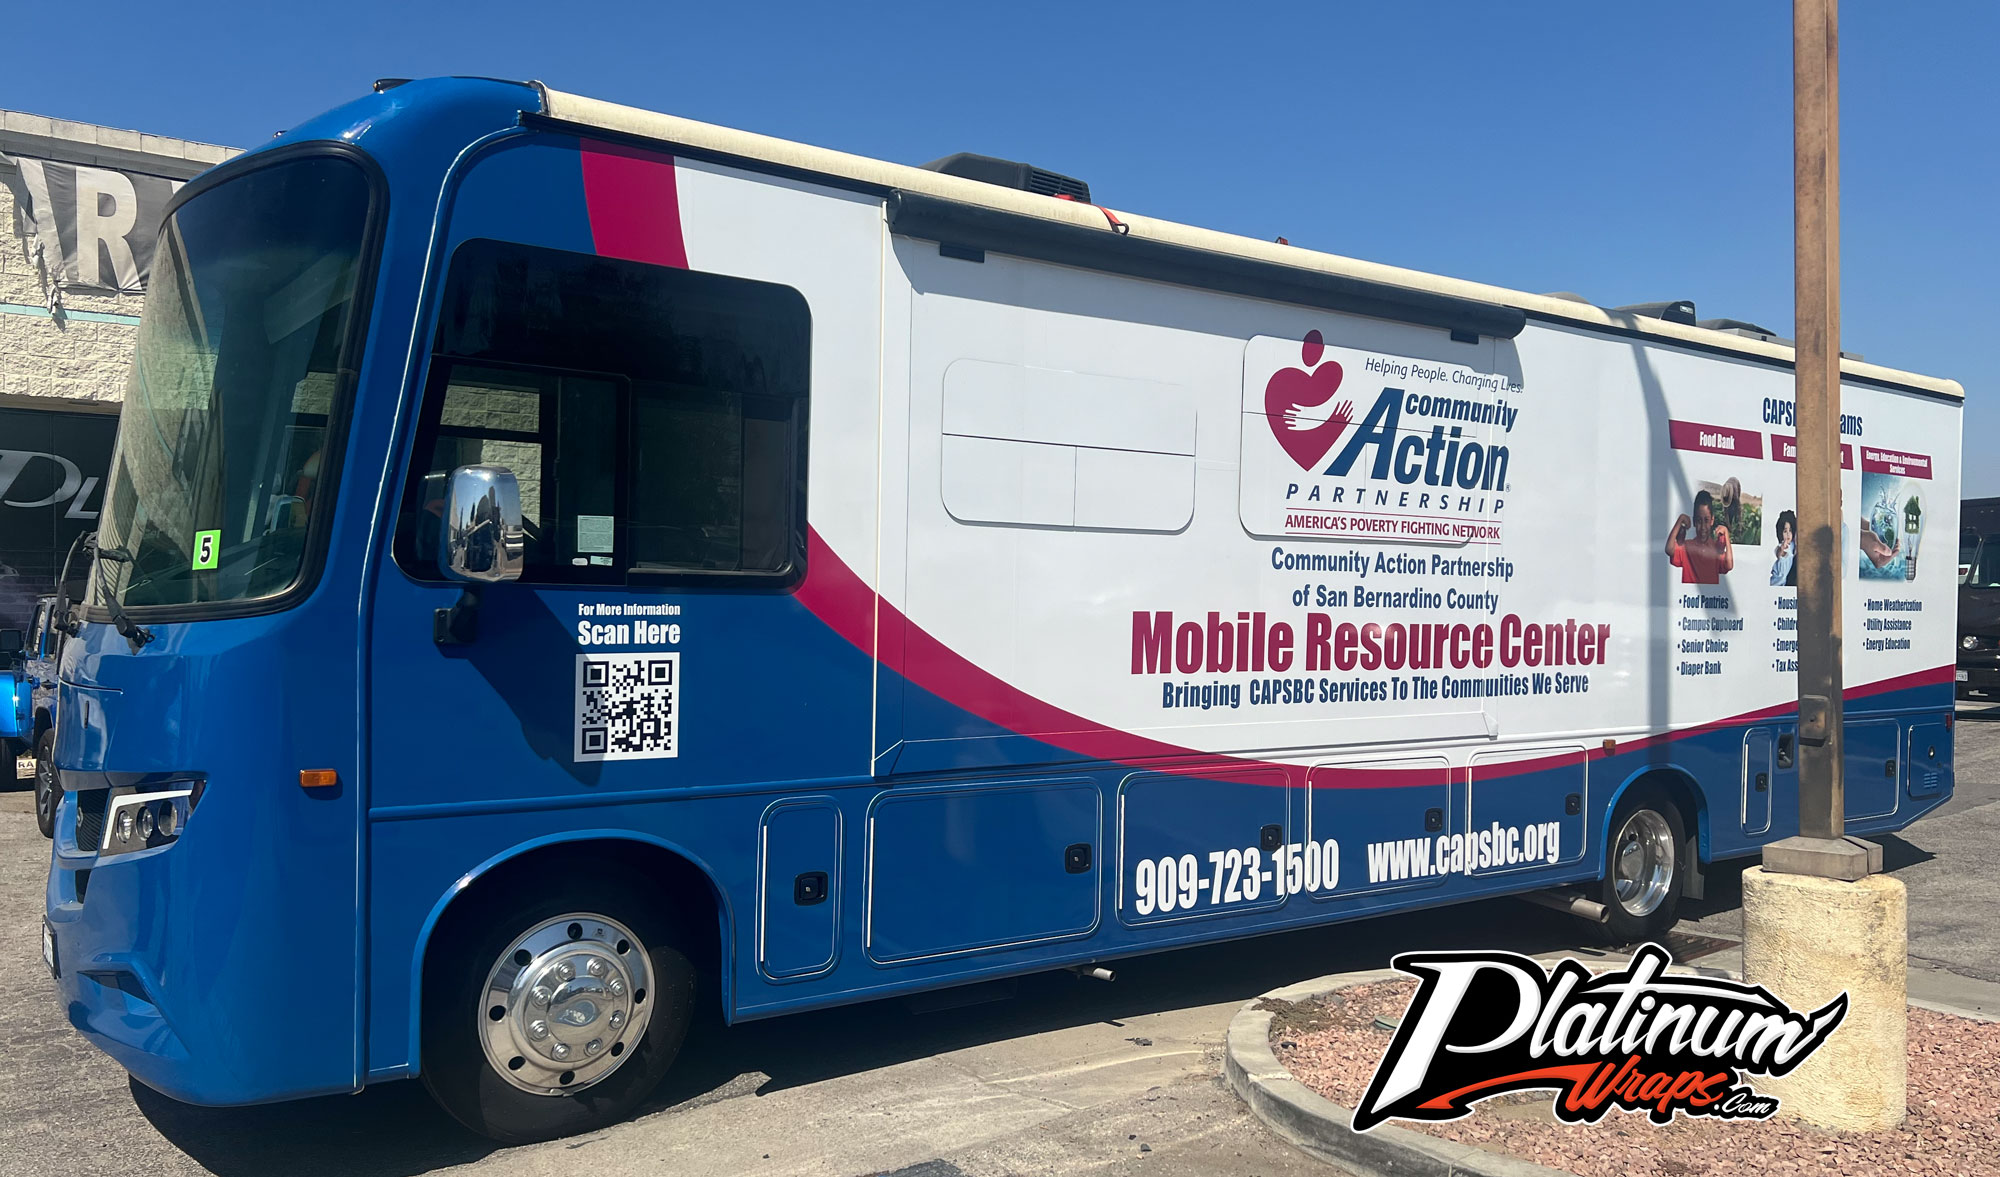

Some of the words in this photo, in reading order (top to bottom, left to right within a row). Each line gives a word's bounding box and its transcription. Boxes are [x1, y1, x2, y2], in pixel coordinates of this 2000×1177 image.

[1365, 357, 1408, 380] Helping
[1410, 364, 1449, 384] People.
[1452, 370, 1499, 393] Changing
[1500, 378, 1524, 395] Lves.
[1405, 392, 1519, 433] community
[1763, 397, 1797, 427] CAPS
[1323, 387, 1509, 491] Action
[1700, 432, 1716, 449] Food
[1717, 435, 1735, 450] Bank
[1286, 483, 1505, 514] PARTNERSHIP
[1285, 514, 1348, 532] AMERICA'S
[1350, 520, 1398, 535] POVERTY
[1400, 523, 1450, 537] FIGHTING
[1452, 526, 1501, 539] NETWORK
[199, 535, 213, 564] 5
[1271, 547, 1370, 578] Community
[1374, 552, 1426, 576] Action
[1431, 554, 1514, 582] Partnership
[578, 604, 594, 615] For
[596, 604, 622, 615] More
[623, 604, 680, 615] Information
[1292, 585, 1311, 608] of
[1316, 585, 1348, 608] San
[1353, 586, 1442, 609] Bernardino
[1447, 589, 1499, 615] County
[1683, 595, 1699, 608] Food
[1701, 595, 1729, 609] Pantries
[1778, 597, 1797, 609] Housi
[1868, 599, 1882, 610] Home
[1884, 599, 1922, 611] Weatherization
[578, 621, 629, 645] Scan
[634, 621, 680, 644] Here
[1682, 617, 1710, 632] Campus
[1711, 617, 1743, 632] Cupboard
[1867, 618, 1882, 631] Utility
[1883, 618, 1911, 630] Assistance
[1131, 611, 1294, 675] Mobile
[1305, 612, 1494, 672] Resource
[1500, 613, 1610, 667] Center
[1681, 639, 1704, 653] Senior
[1705, 639, 1728, 653] Choice
[1866, 638, 1883, 651] Energy
[1885, 638, 1910, 649] Education
[1681, 661, 1703, 676] Diaper
[1704, 661, 1721, 674] Bank
[1776, 659, 1786, 671] Tax
[1162, 679, 1241, 709] Bringing
[1249, 680, 1315, 704] CAPSBC
[1319, 677, 1387, 702] Services
[1391, 677, 1408, 699] To
[1412, 676, 1438, 699] The
[1441, 673, 1529, 698] Communities
[1532, 672, 1553, 693] We
[1555, 671, 1590, 693] Serve
[1135, 839, 1339, 915] 909-723-1500
[1367, 822, 1560, 883] www.capsbc.org
